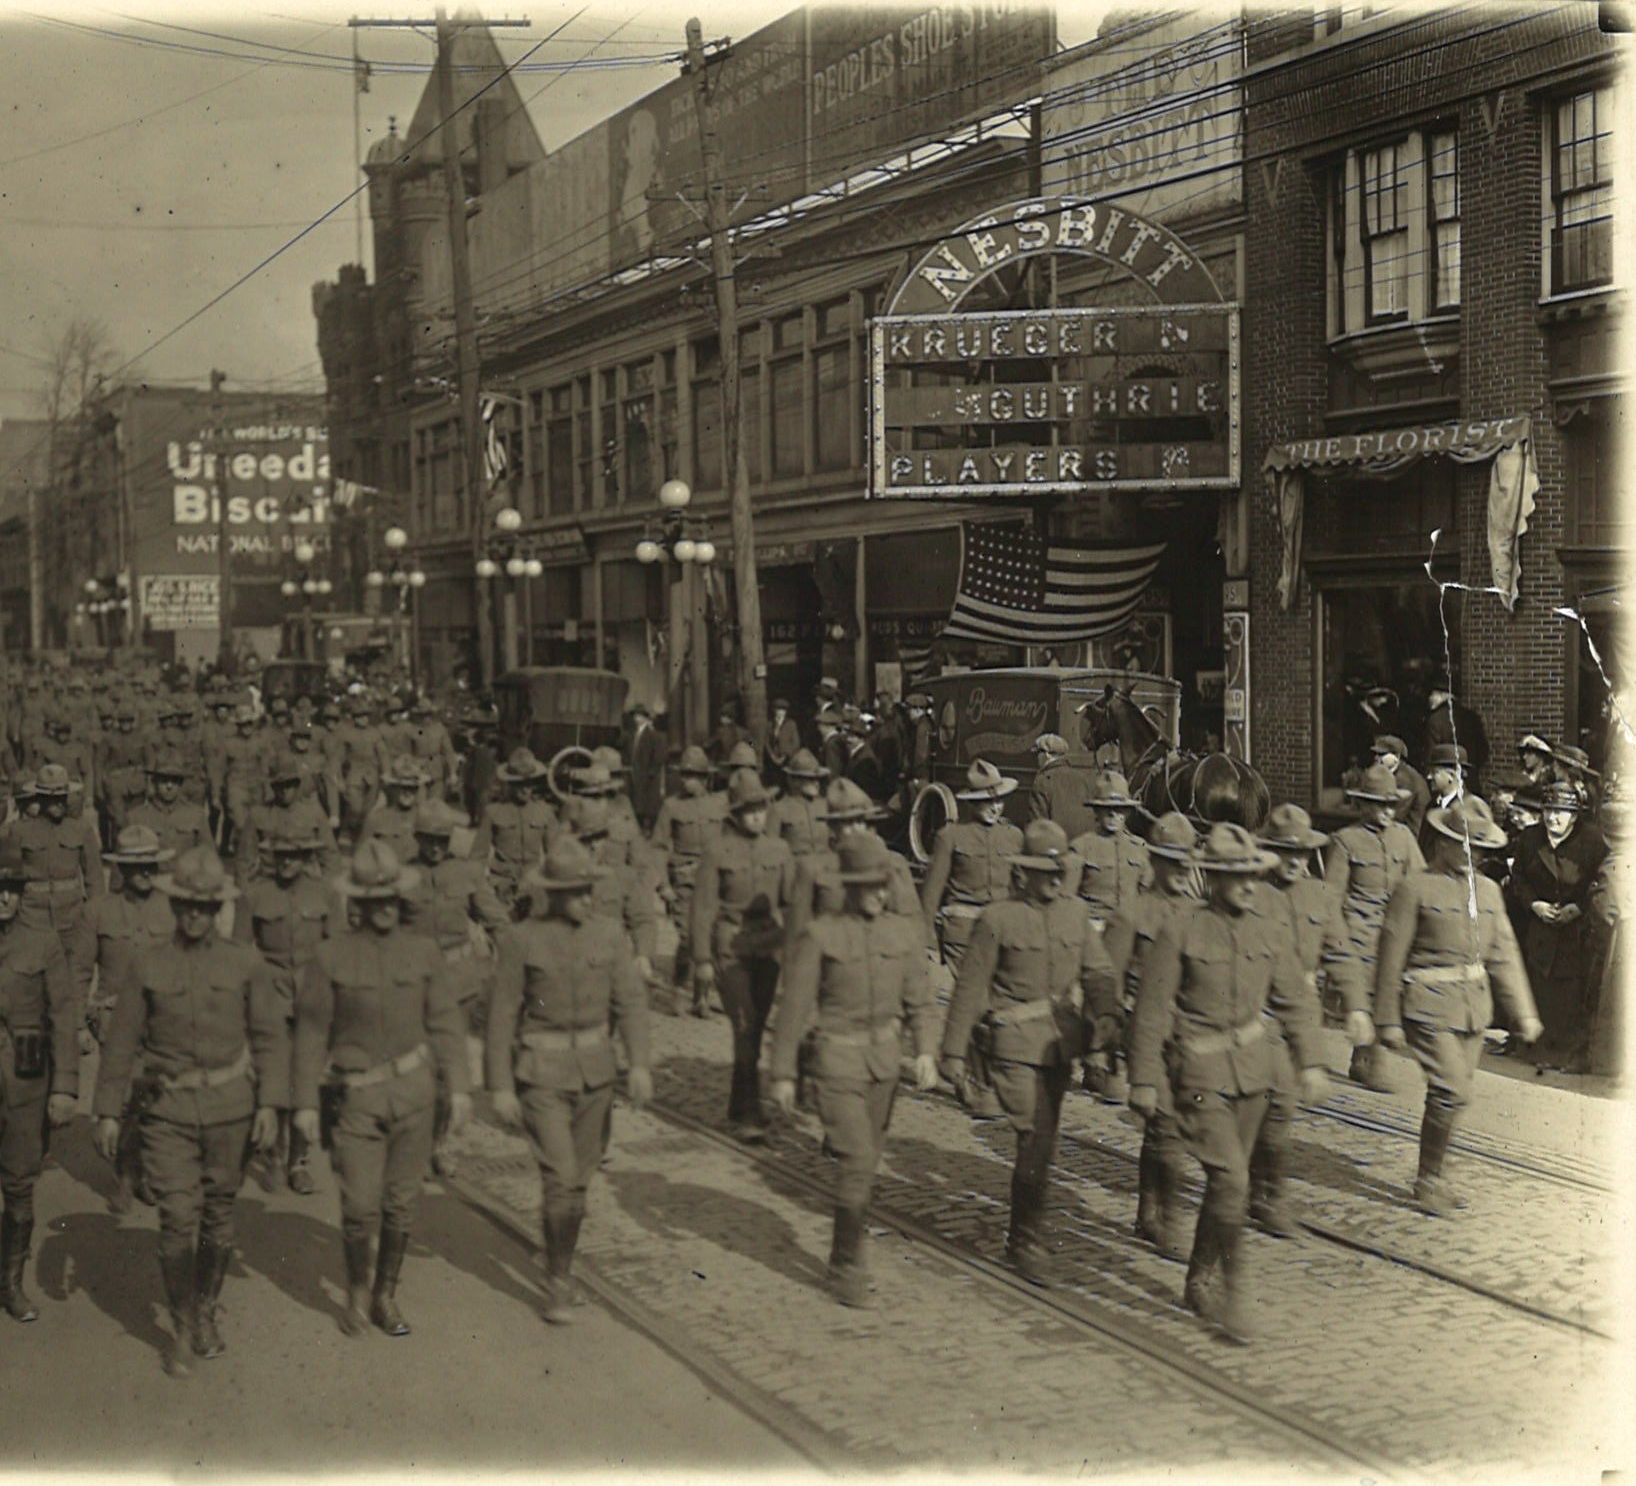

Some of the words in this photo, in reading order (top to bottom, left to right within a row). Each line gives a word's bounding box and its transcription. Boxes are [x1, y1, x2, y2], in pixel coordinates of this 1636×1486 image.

[813, 33, 895, 115] PEOPLES
[900, 6, 954, 66] SHOE
[919, 202, 1193, 301] NESBITT
[890, 322, 1117, 357] KRUEGER
[989, 382, 1221, 420] GUTHRIE
[1286, 440, 1341, 460] THE
[1354, 419, 1513, 455] FLORIST
[890, 449, 1117, 484] PLAYERS
[174, 485, 331, 523] Bisci
[176, 535, 273, 553] NATONAL
